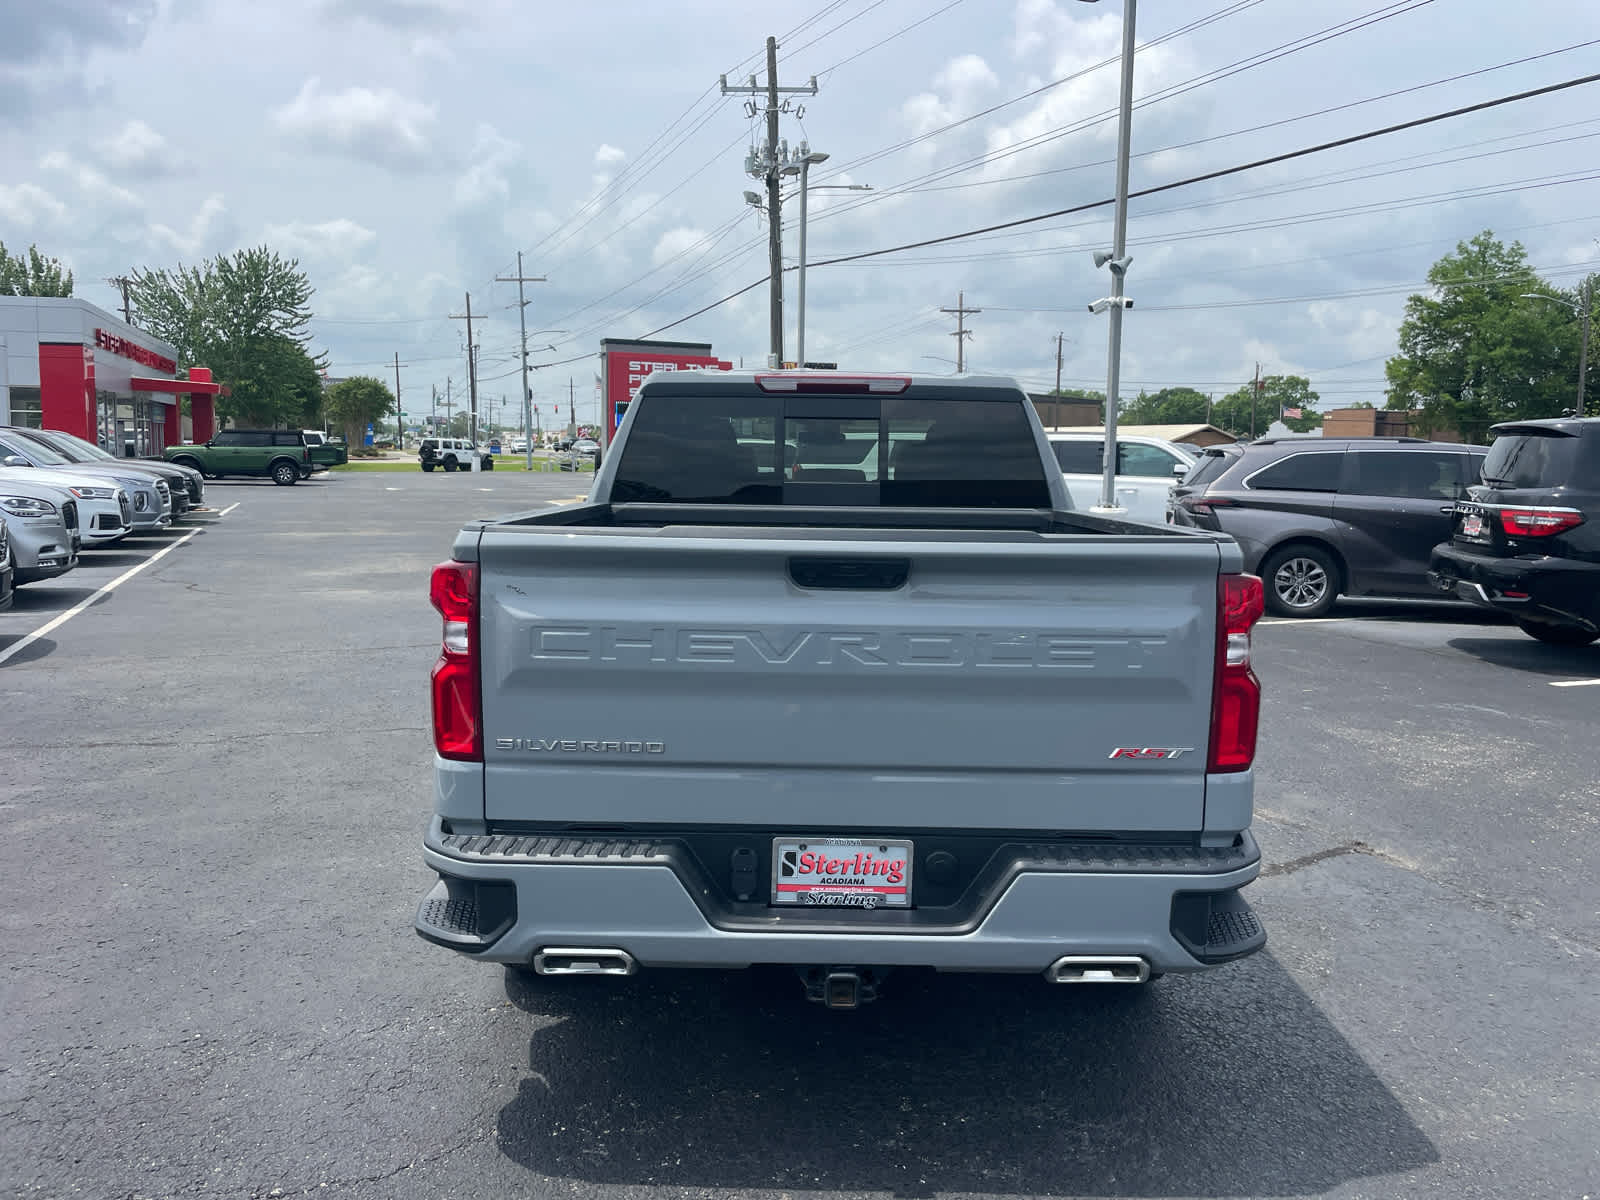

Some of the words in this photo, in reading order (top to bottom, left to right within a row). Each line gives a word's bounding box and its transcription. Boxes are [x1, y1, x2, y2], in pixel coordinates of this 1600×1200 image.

[529, 625, 1168, 670] CHEVROLET
[496, 738, 665, 753] SILVERADO
[1108, 747, 1195, 759] RST
[798, 851, 907, 884] Sterling
[820, 877, 866, 885] ACADIANA
[805, 892, 878, 909] Sterling
